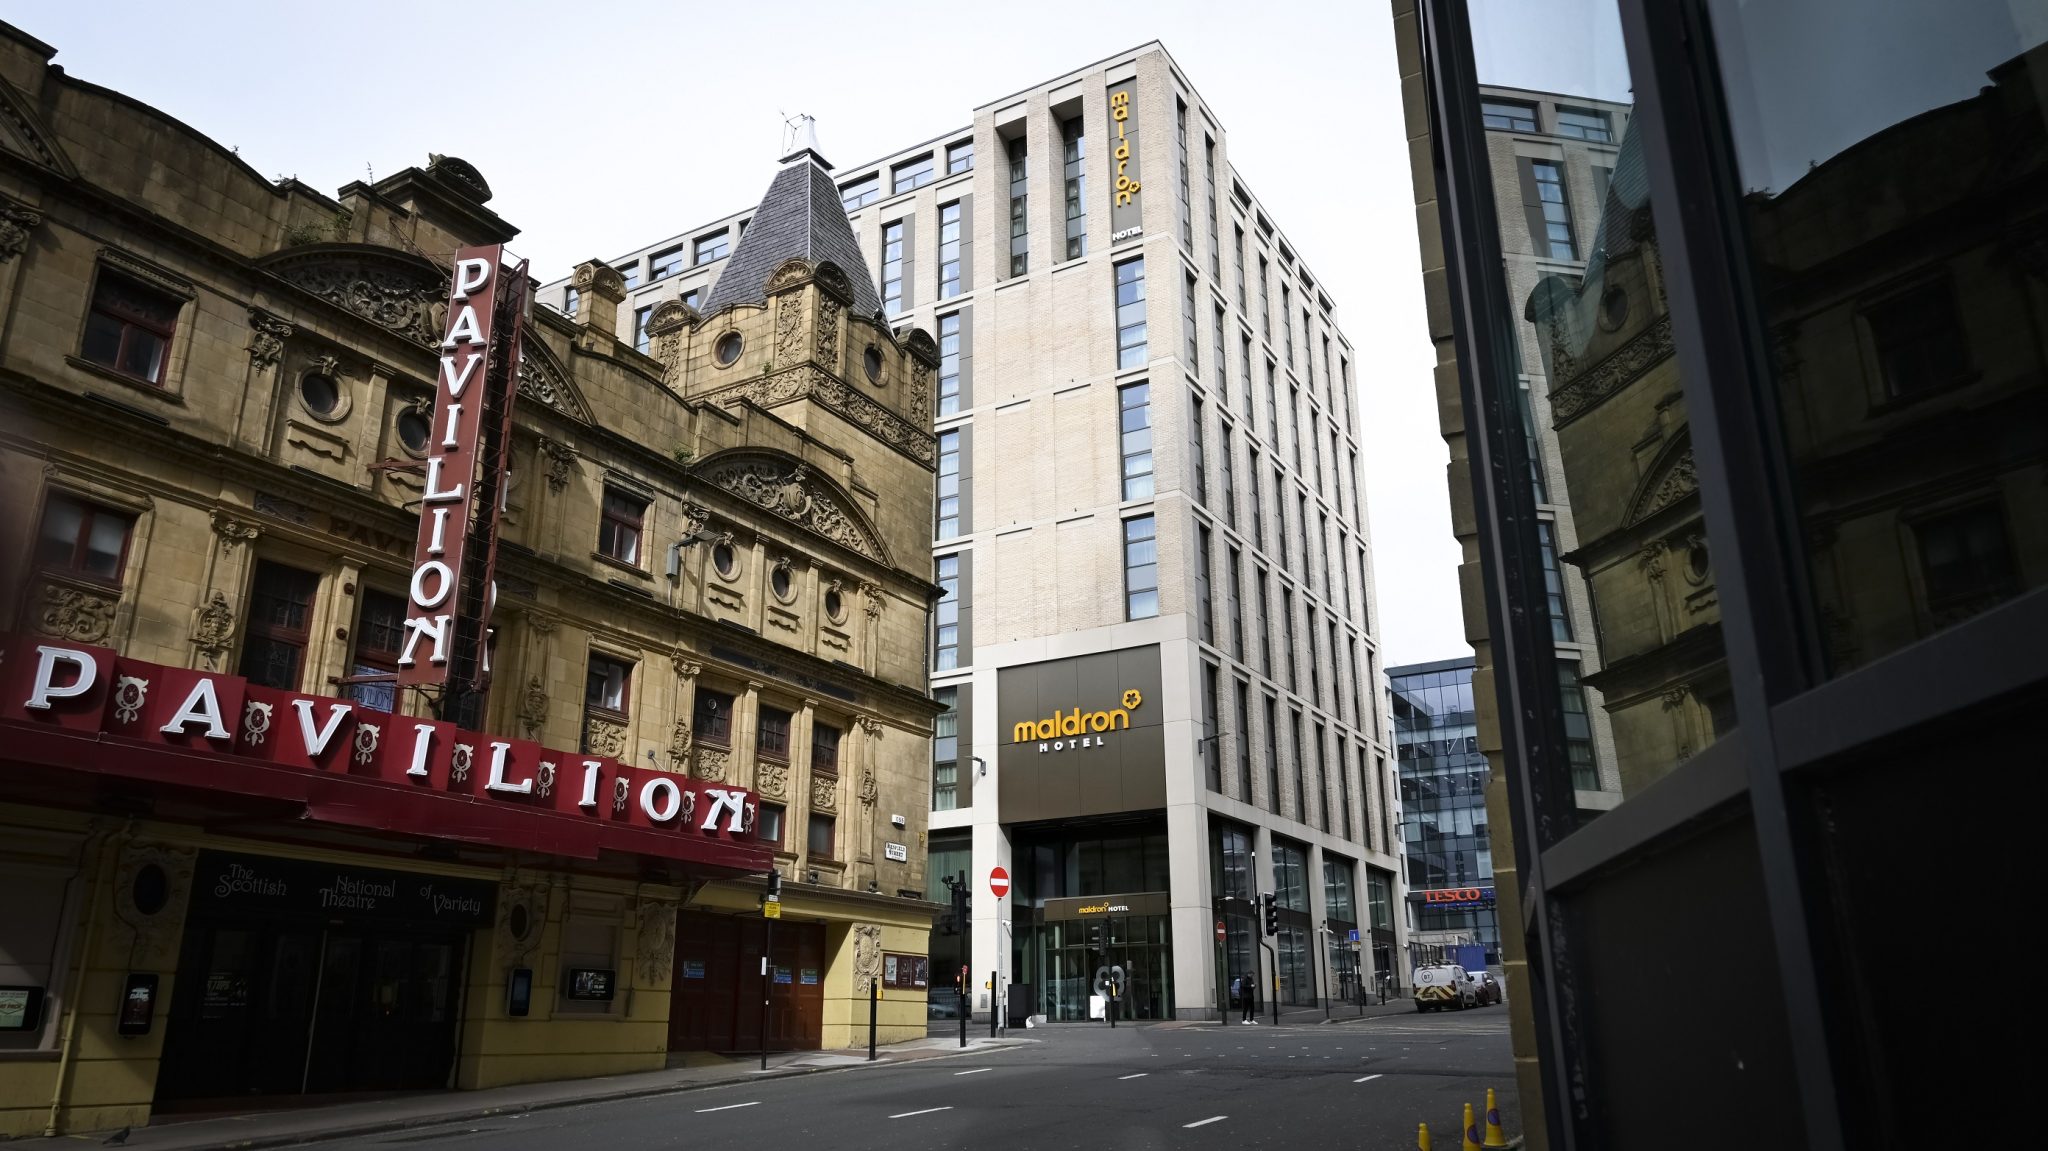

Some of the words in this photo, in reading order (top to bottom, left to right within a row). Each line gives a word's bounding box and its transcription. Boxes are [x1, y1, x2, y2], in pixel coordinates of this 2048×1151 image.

[1111, 90, 1134, 208] maldron
[1112, 225, 1143, 242] HOTEL
[398, 257, 492, 666] PAVILION
[1014, 707, 1129, 743] maldron
[25, 645, 746, 833] PAVILION
[1039, 736, 1104, 753] HOTEL
[230, 864, 254, 881] The
[214, 875, 288, 898] Scottish
[336, 875, 396, 898] National
[419, 883, 433, 898] of
[1424, 889, 1481, 903] TESCO
[319, 888, 376, 910] Theatre
[433, 895, 481, 916] Variety
[1079, 905, 1107, 914] maldron
